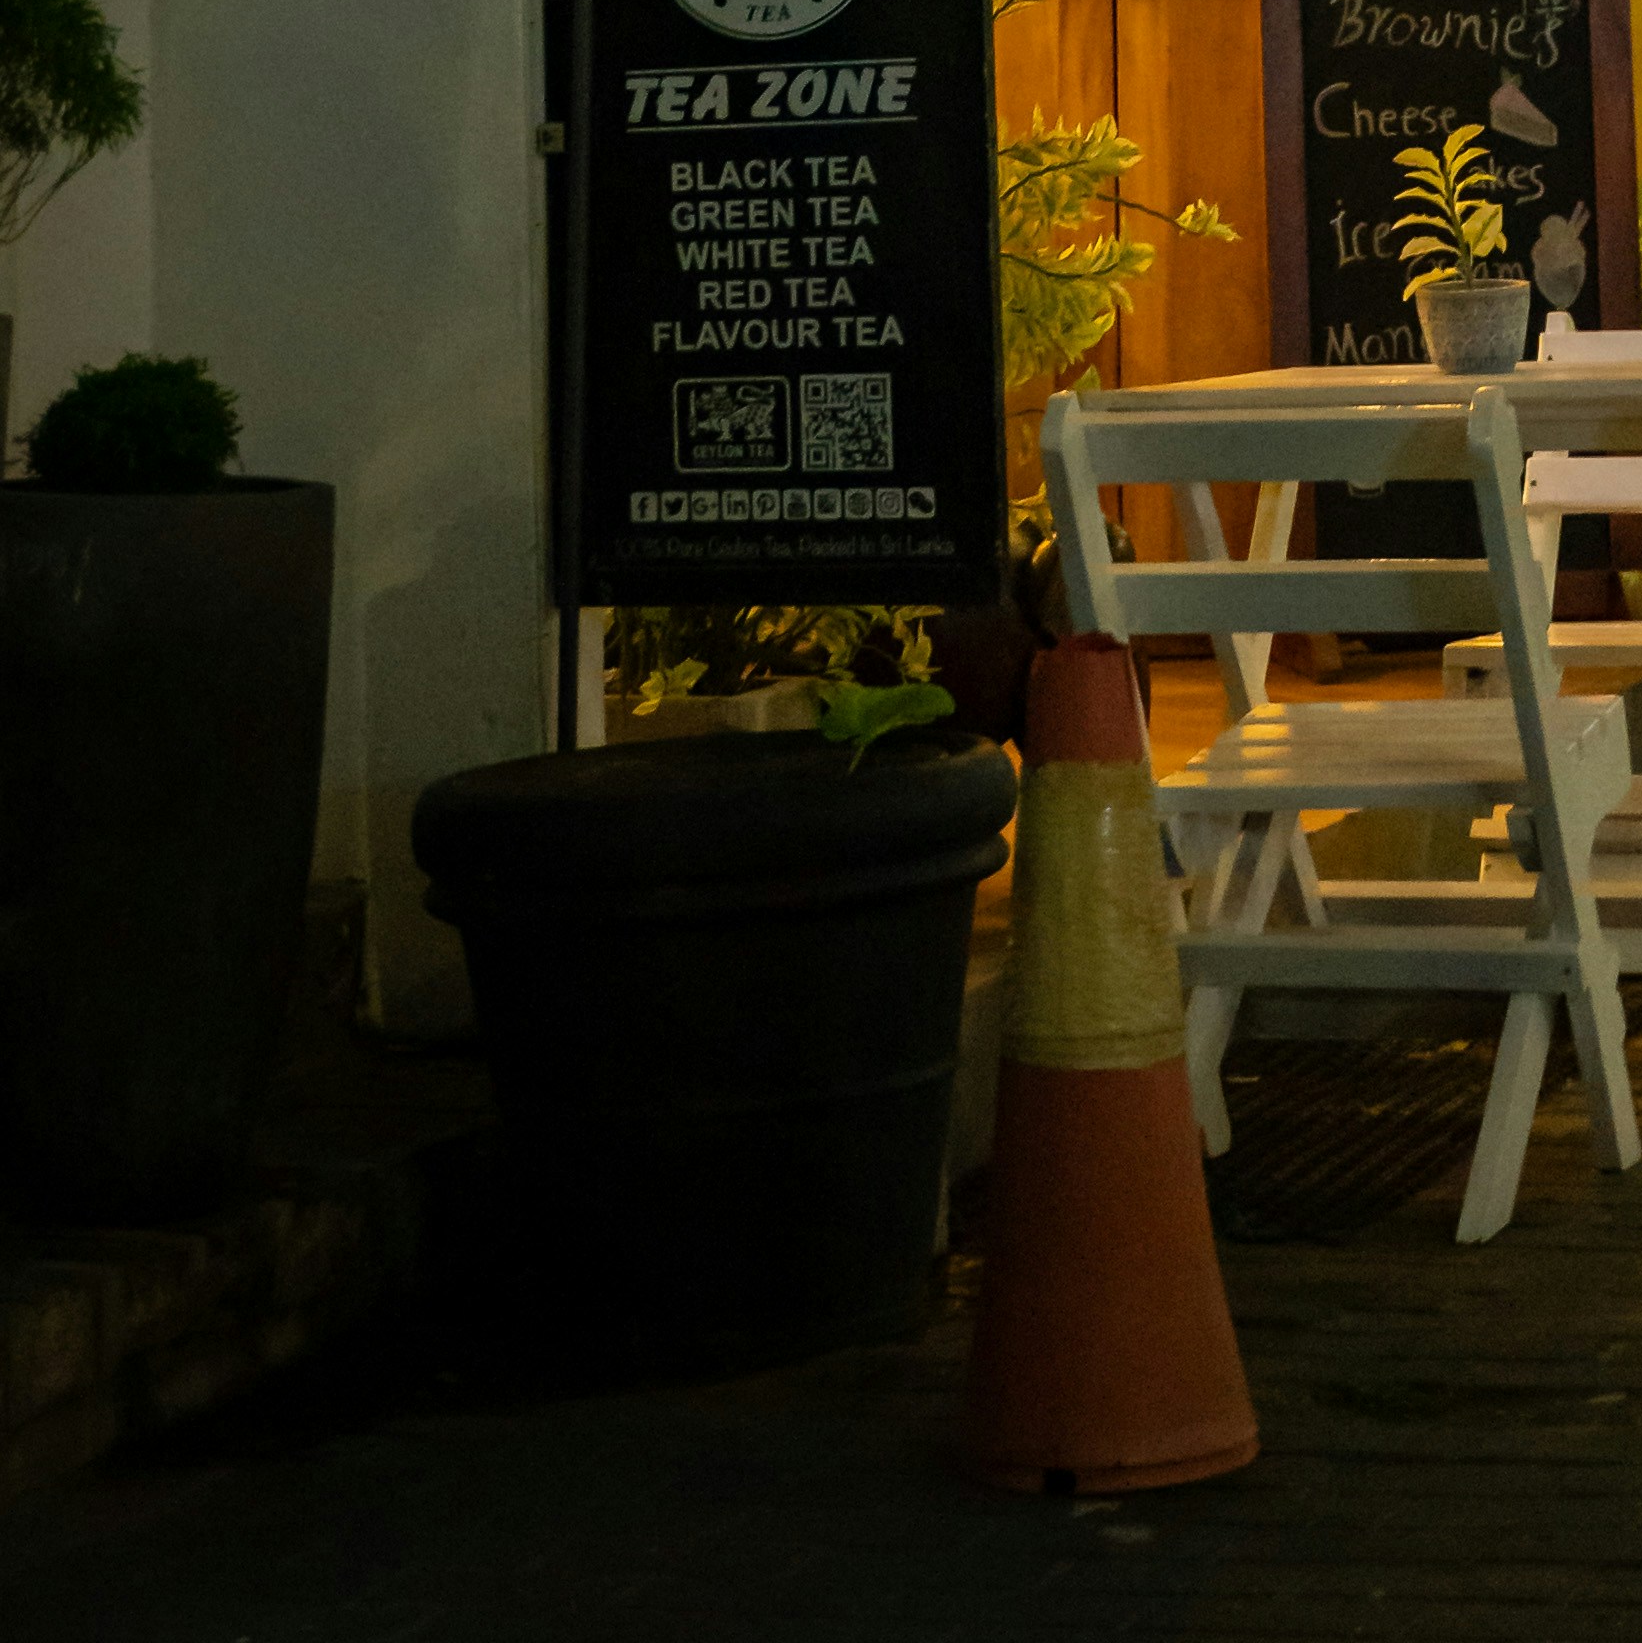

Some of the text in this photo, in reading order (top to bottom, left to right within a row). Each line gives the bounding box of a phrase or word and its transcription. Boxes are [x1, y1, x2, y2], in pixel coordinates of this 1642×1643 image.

[745, 3, 792, 23] TEA
[625, 64, 918, 124] TEA ZONE
[1313, 81, 1458, 140] Cheese
[670, 155, 878, 193] BLACK TEA
[670, 195, 880, 233] GREEN TEA
[676, 235, 875, 271] WHITE TEA
[699, 276, 856, 312] RED TEA
[652, 314, 905, 354] FLAVOUR TEA
